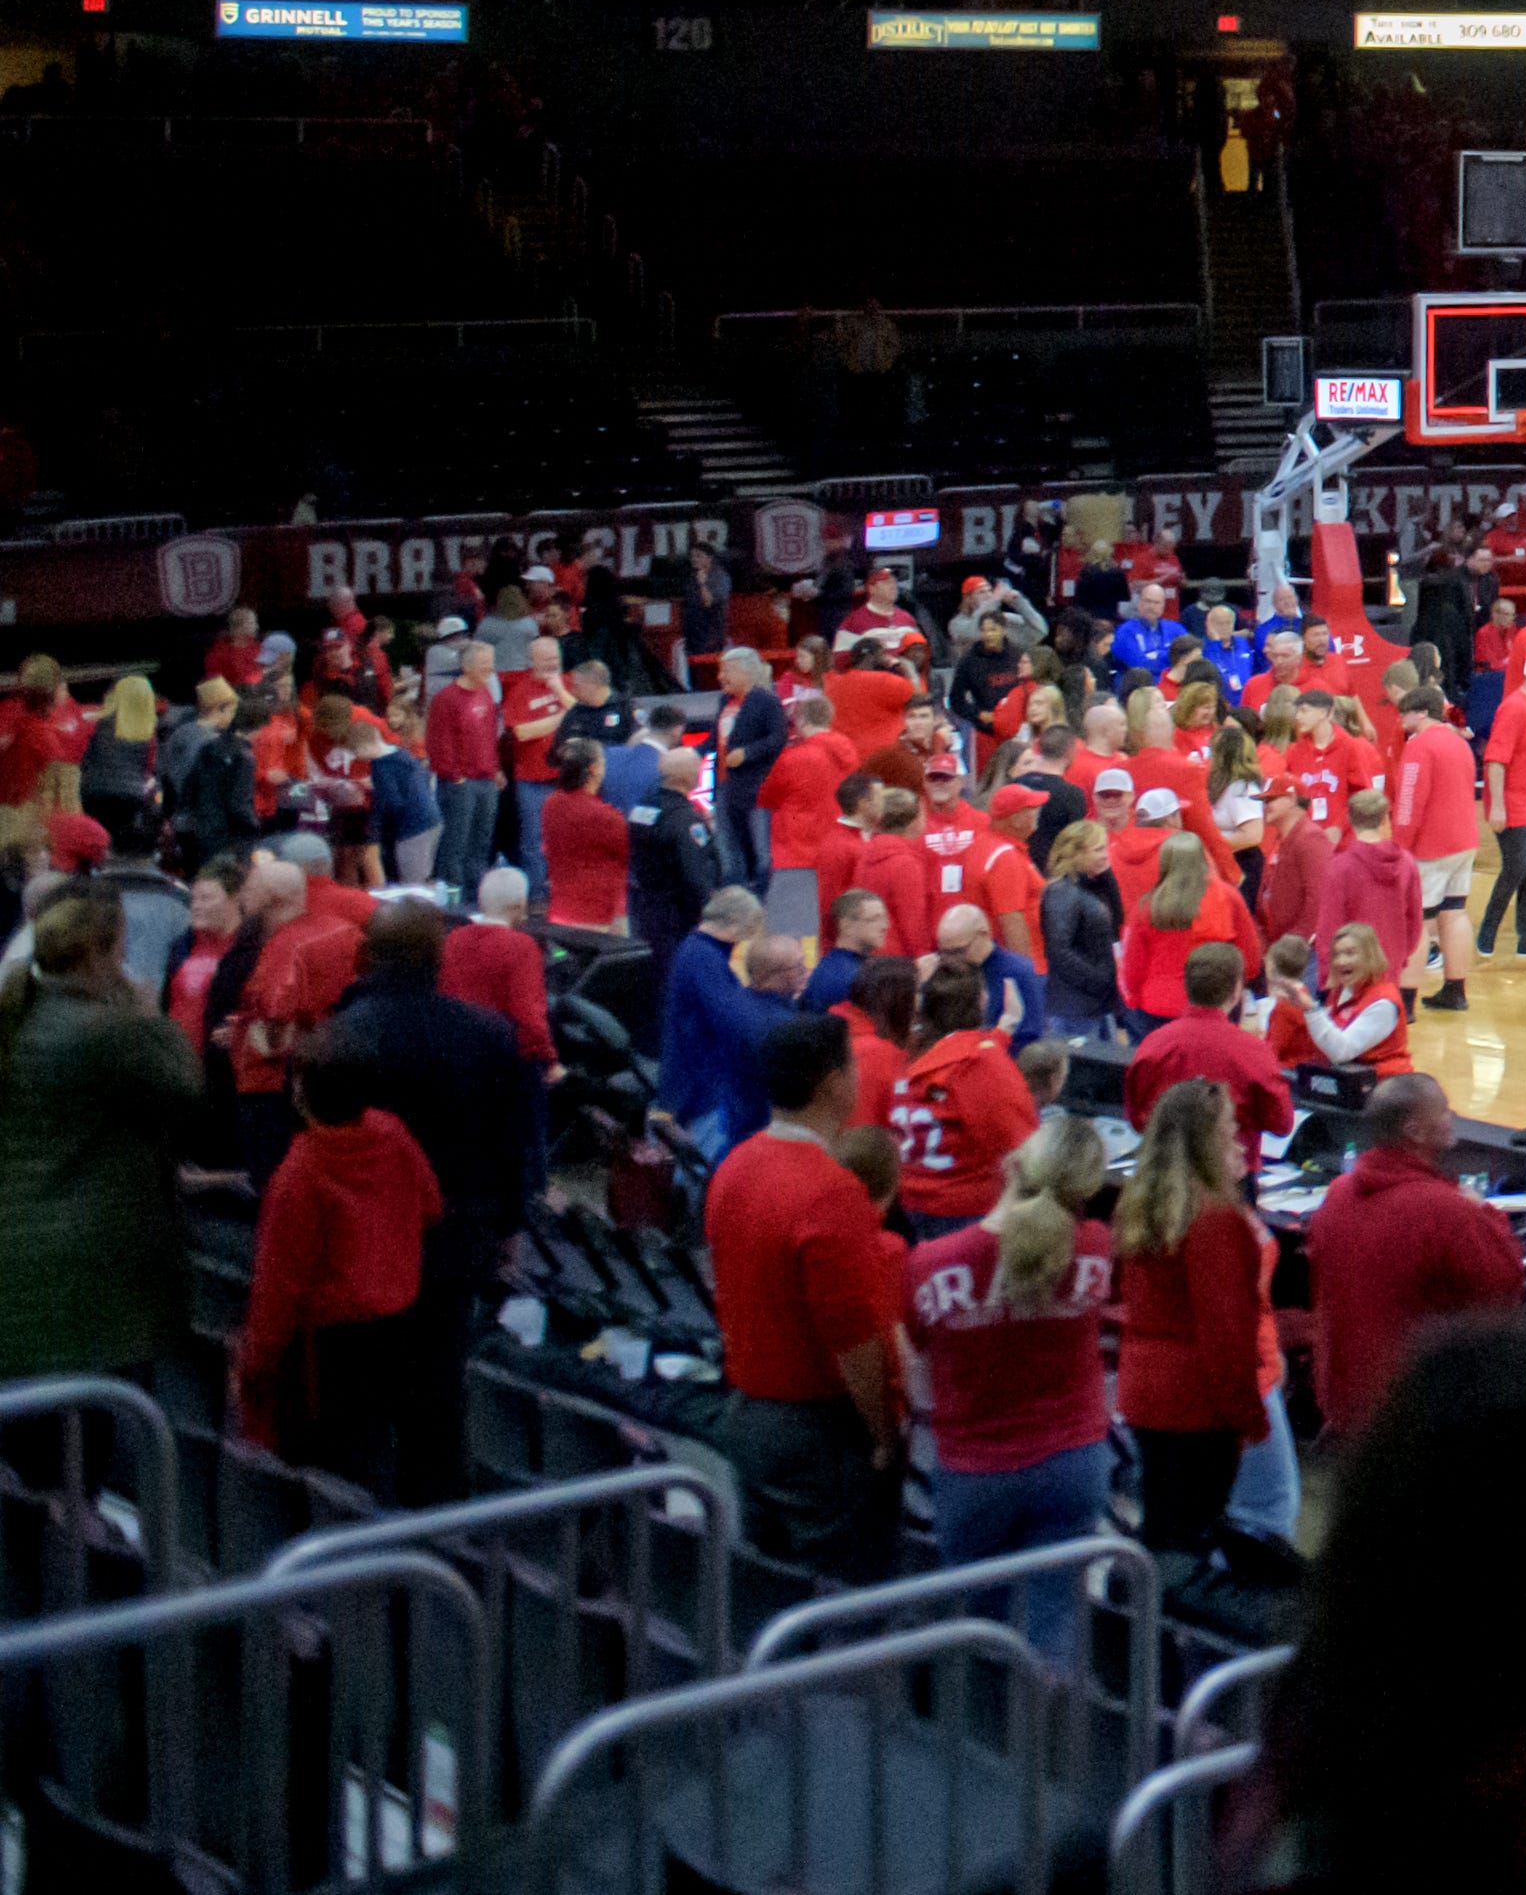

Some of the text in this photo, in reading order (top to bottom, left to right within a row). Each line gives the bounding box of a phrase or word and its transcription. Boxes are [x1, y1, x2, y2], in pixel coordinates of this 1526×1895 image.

[245, 8, 348, 26] GRINNELL
[423, 19, 462, 30] SEASON
[871, 19, 944, 44] DISTRICT
[1458, 23, 1487, 40] 309
[1492, 23, 1521, 39] 680
[1328, 382, 1388, 403] RE/MAX
